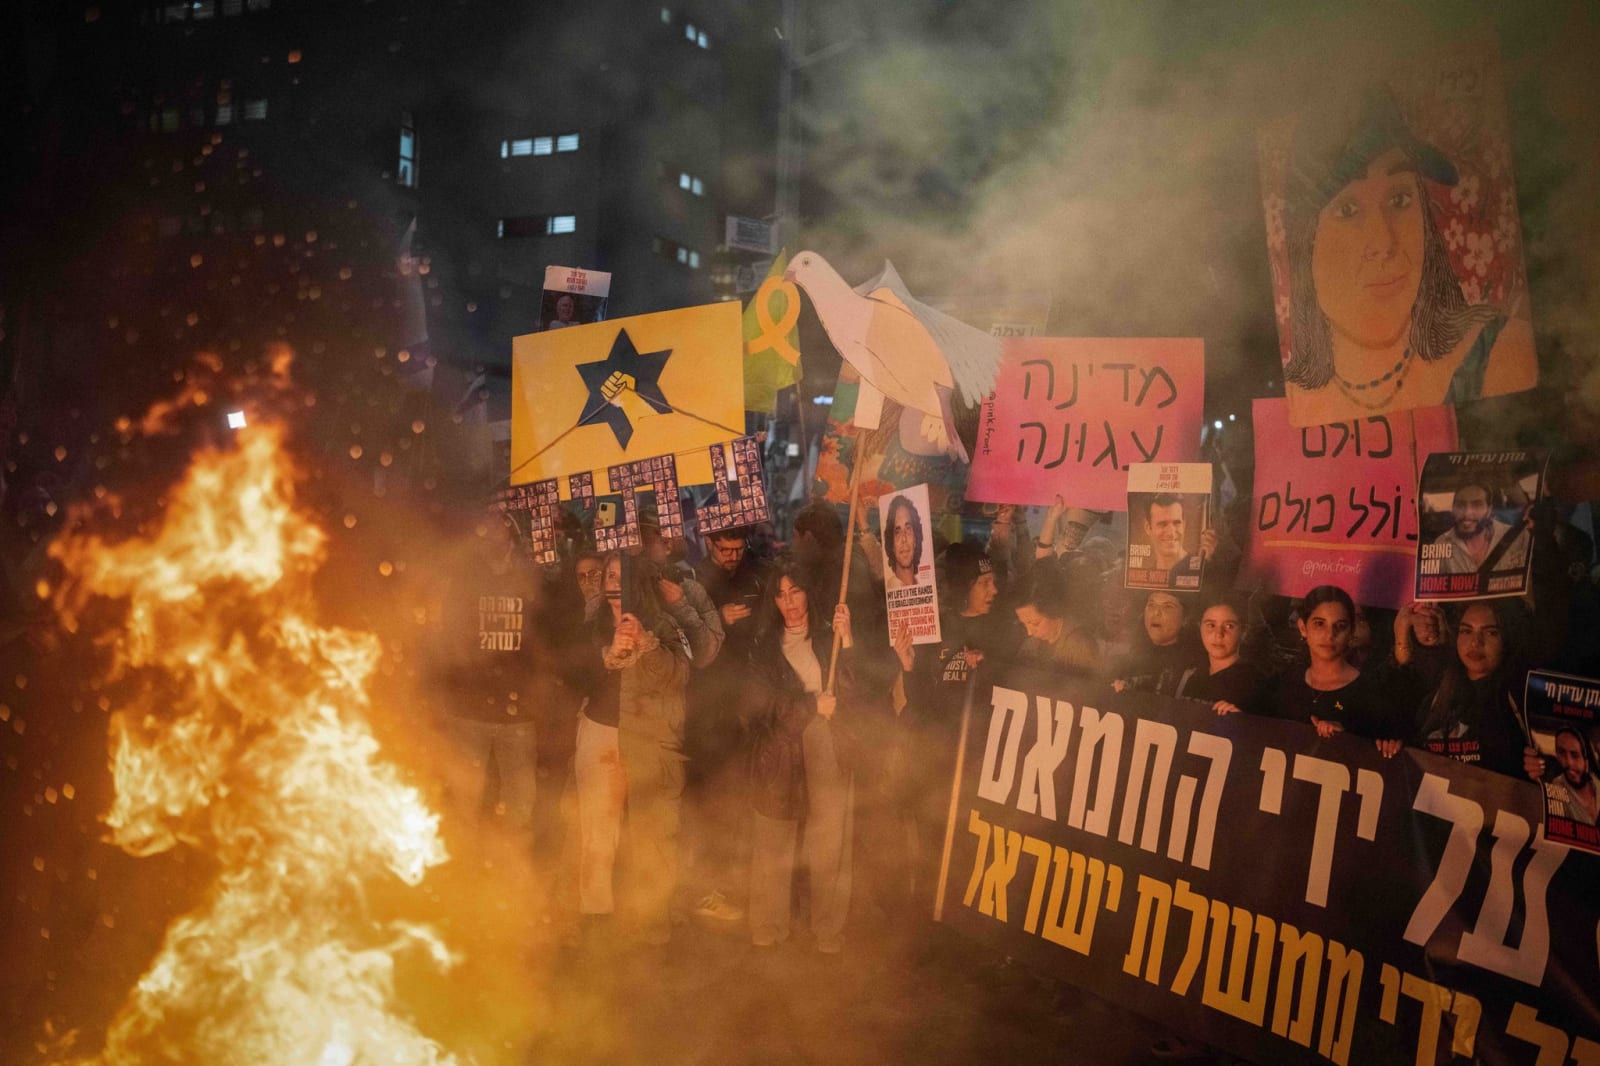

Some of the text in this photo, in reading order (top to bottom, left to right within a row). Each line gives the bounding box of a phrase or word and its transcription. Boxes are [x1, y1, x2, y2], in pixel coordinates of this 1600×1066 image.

[1021, 359, 1178, 410] מדינה
[1421, 543, 1452, 559] BRING
[1420, 559, 1441, 574] HIM
[1419, 575, 1449, 592] HOME
[1450, 574, 1480, 592] NOW!
[1544, 681, 1557, 699] חי
[1557, 684, 1585, 703] עדיין
[1547, 799, 1565, 817] HIM
[977, 685, 1569, 988] על ידי החמאס
[962, 809, 1124, 956] ישראל
[1123, 874, 1364, 1066] ממשלת
[1379, 963, 1482, 1066] ידי
